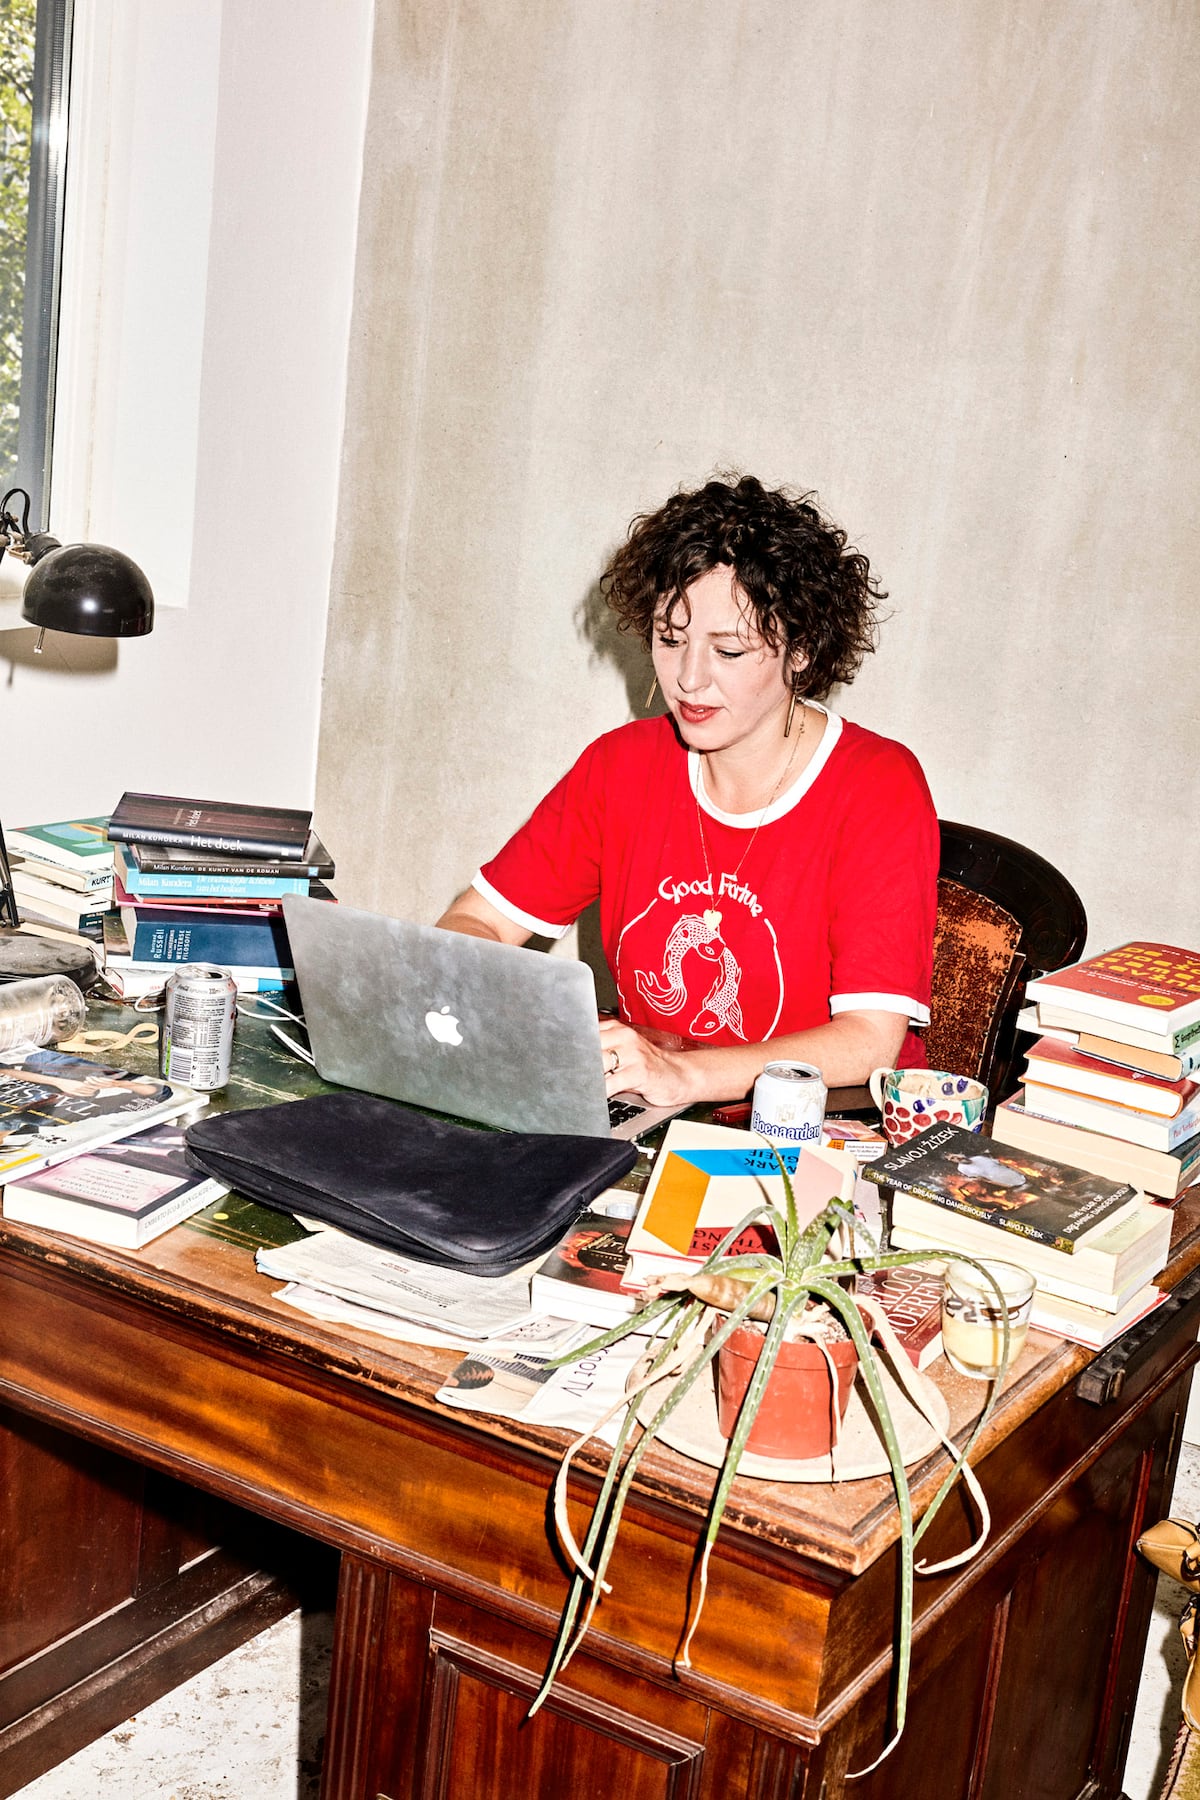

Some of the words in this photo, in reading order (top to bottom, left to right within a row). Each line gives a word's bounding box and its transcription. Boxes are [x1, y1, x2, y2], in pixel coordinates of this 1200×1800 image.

[123, 831, 145, 841] MILAN
[148, 833, 183, 844] KUNDERA
[190, 835, 213, 848] Het
[215, 838, 242, 852] doek
[91, 875, 111, 886] KURT
[138, 878, 159, 886] Milan
[161, 879, 193, 888] Kundera
[658, 873, 714, 905] Good
[153, 929, 165, 959] Russell
[176, 930, 186, 960] WESTERSE
[182, 930, 192, 960] FILOSOFIE
[752, 1110, 821, 1140] Hoegaarden
[883, 1147, 928, 1171] SLAVOJ
[920, 1127, 960, 1150] ŽIŽEK
[743, 1158, 797, 1174] MARK
[872, 1172, 886, 1183] THE
[886, 1177, 904, 1189] YEAR
[903, 1183, 913, 1191] OF
[912, 1187, 946, 1204] DREAMING
[945, 1199, 993, 1220] DANGEROUSLY
[999, 1218, 1024, 1232] SLAVOJ
[871, 1269, 923, 1311] RLOG
[561, 1380, 594, 1398] TV
